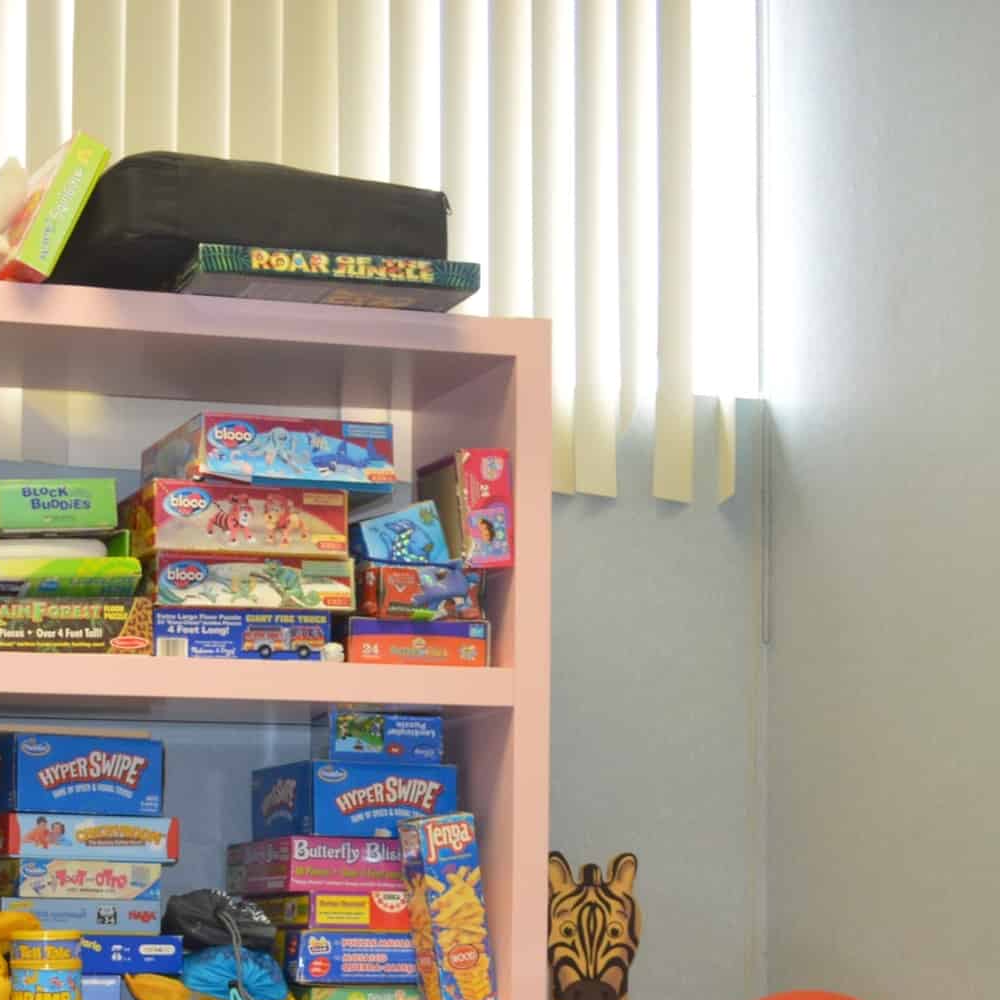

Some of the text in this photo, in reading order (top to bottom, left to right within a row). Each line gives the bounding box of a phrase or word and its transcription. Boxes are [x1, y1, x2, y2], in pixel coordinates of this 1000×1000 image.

[251, 249, 330, 274] ROAR
[293, 840, 403, 864] Butterfly Blis
[423, 822, 473, 864] Jenga
